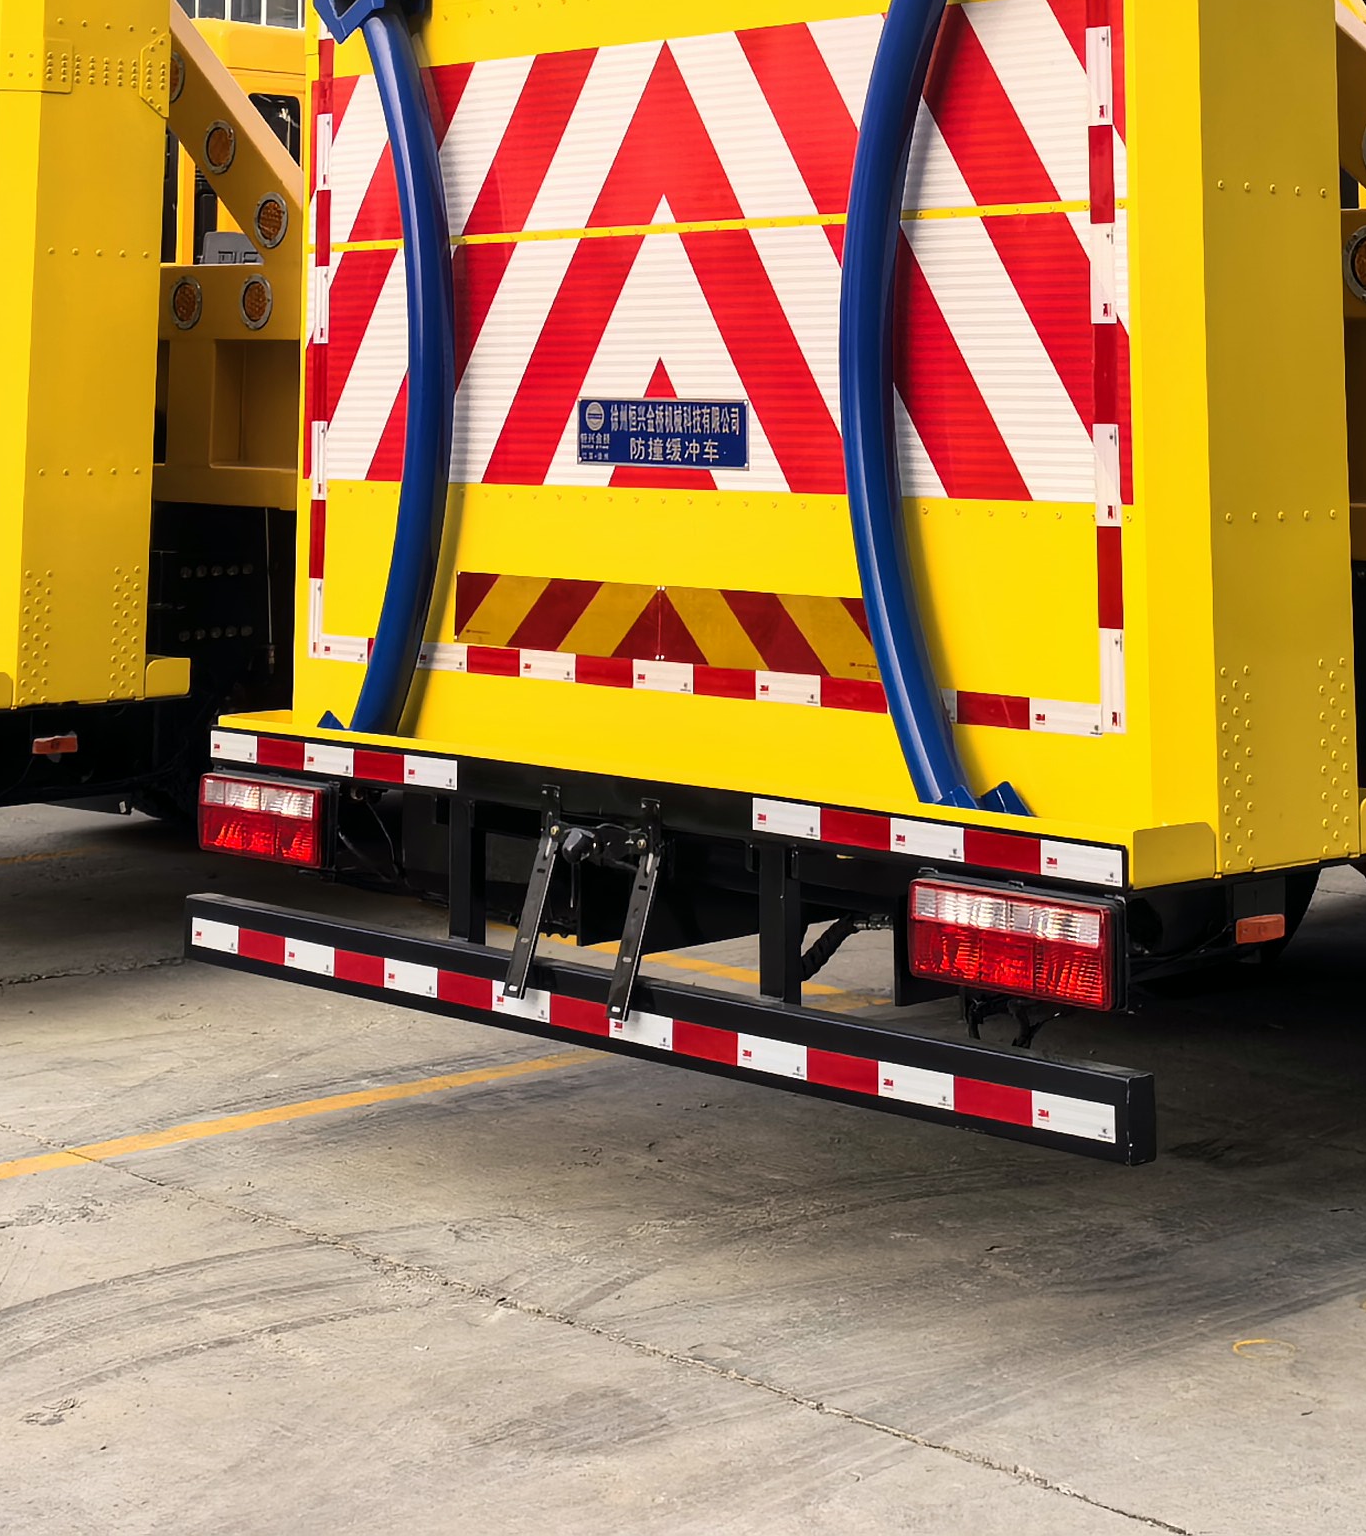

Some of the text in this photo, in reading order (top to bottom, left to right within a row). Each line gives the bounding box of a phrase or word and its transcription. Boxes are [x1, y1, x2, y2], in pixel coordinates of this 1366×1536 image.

[630, 437, 720, 462] 防撞缓冲车
